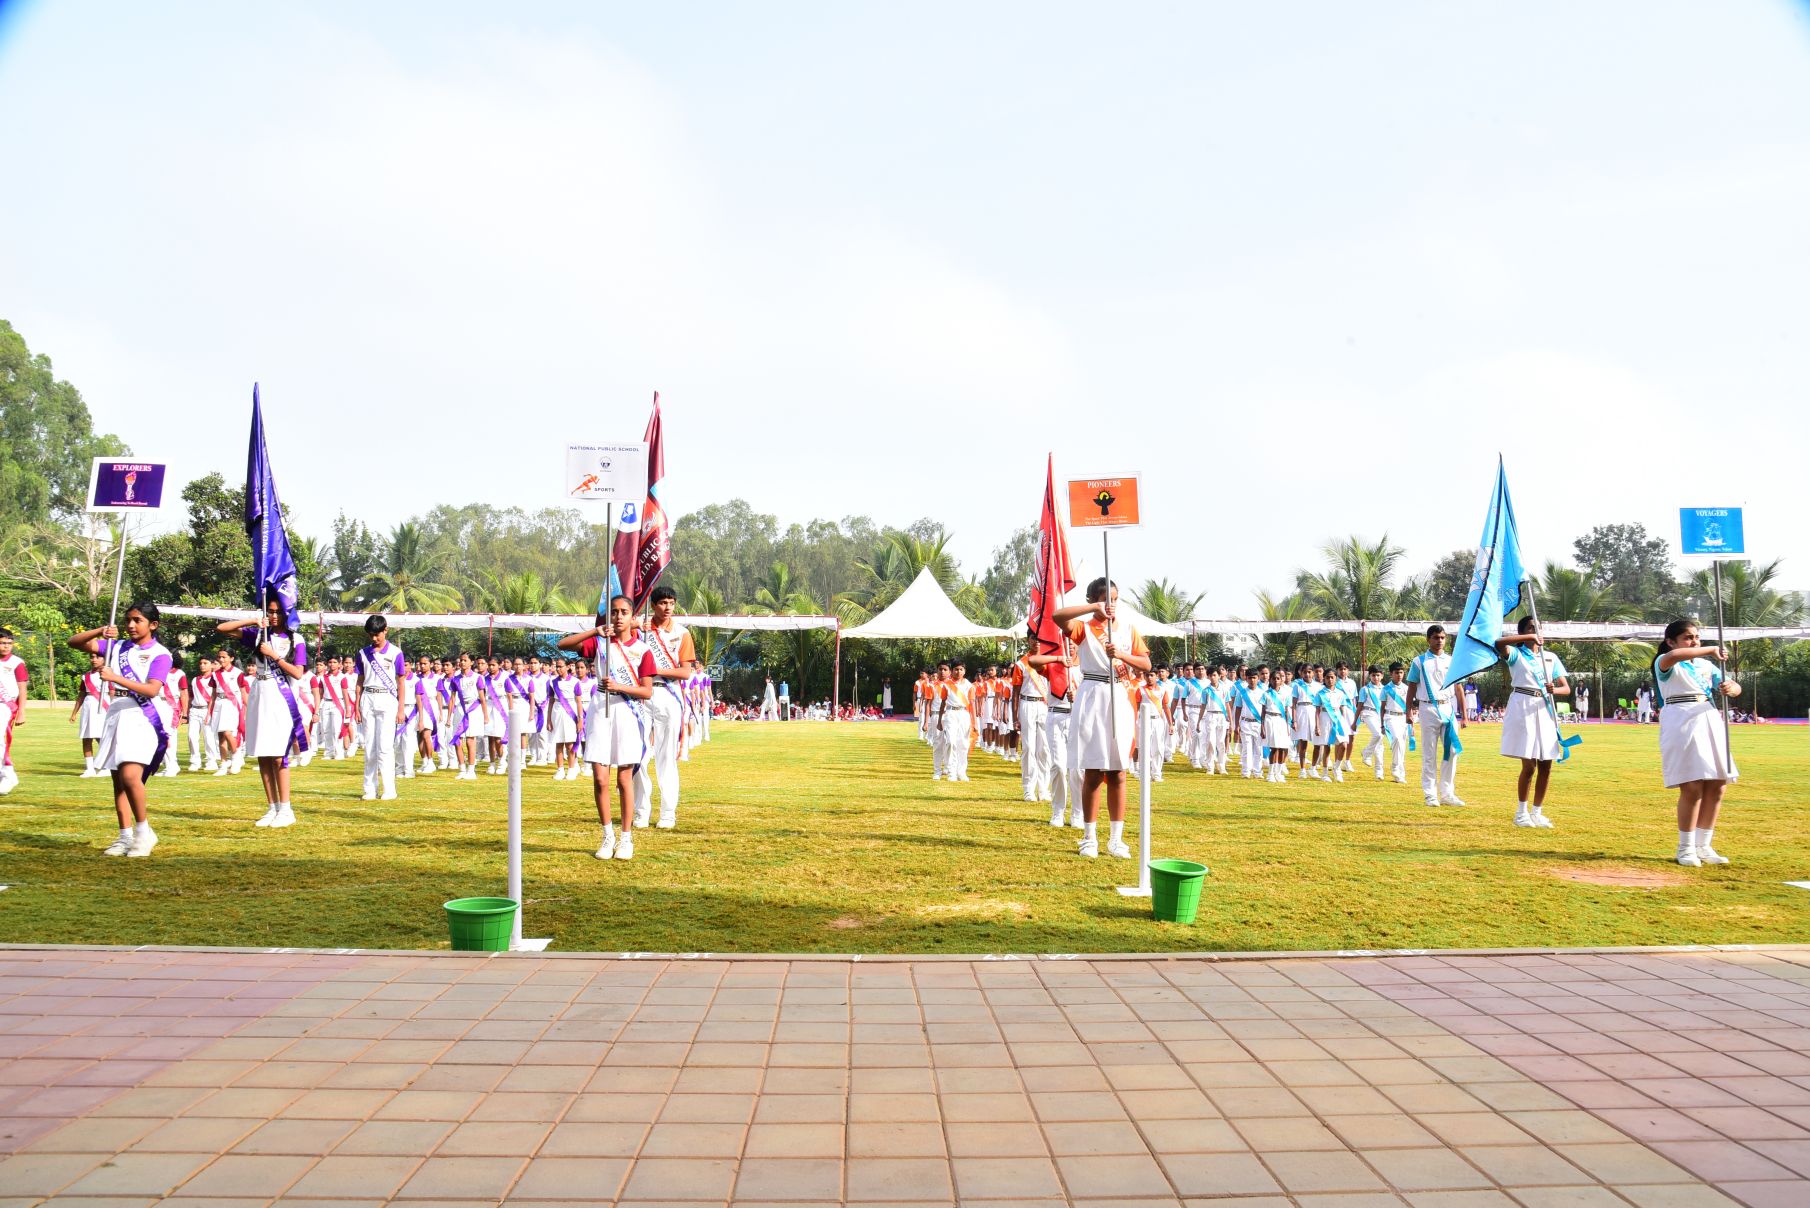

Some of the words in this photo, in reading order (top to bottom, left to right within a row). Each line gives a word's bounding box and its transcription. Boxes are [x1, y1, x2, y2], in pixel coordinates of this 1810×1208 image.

[112, 464, 153, 472] EXPLORERS
[1087, 480, 1122, 489] PIONEERS
[1695, 509, 1729, 517] VOYAGERS
[119, 650, 129, 669] VICE
